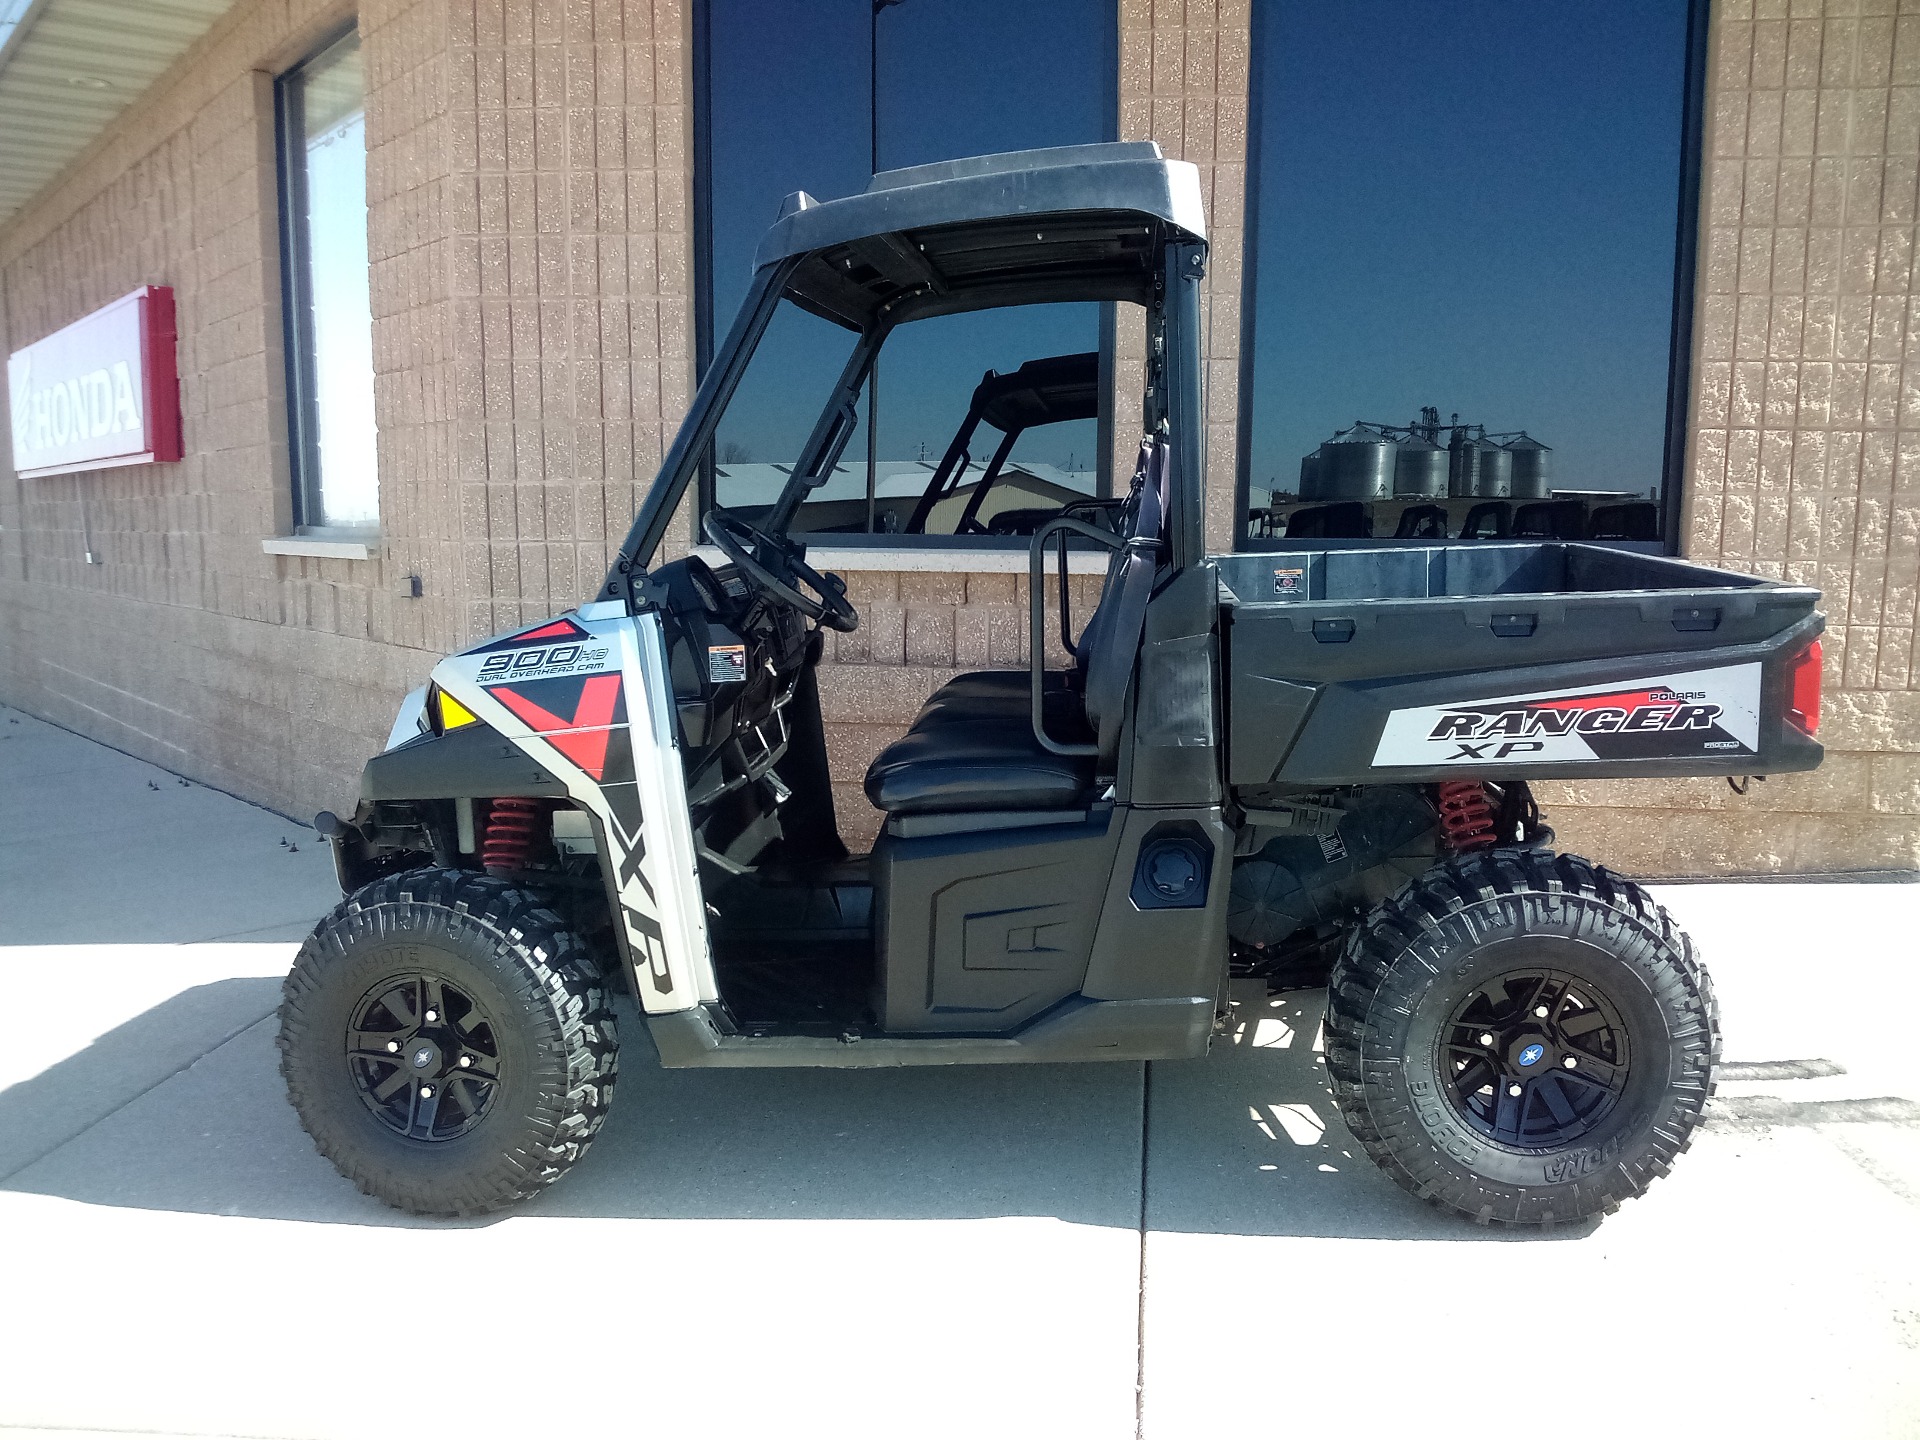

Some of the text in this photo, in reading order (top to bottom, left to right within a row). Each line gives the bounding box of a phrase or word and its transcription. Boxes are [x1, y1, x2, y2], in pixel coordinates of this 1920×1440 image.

[33, 360, 142, 450] HONDA
[476, 662, 605, 682] DUAL OVERHEAD CAM
[478, 644, 584, 675] 900
[1649, 691, 1706, 701] POLARIS
[1426, 703, 1723, 741] RANGER
[1443, 741, 1545, 760] XP
